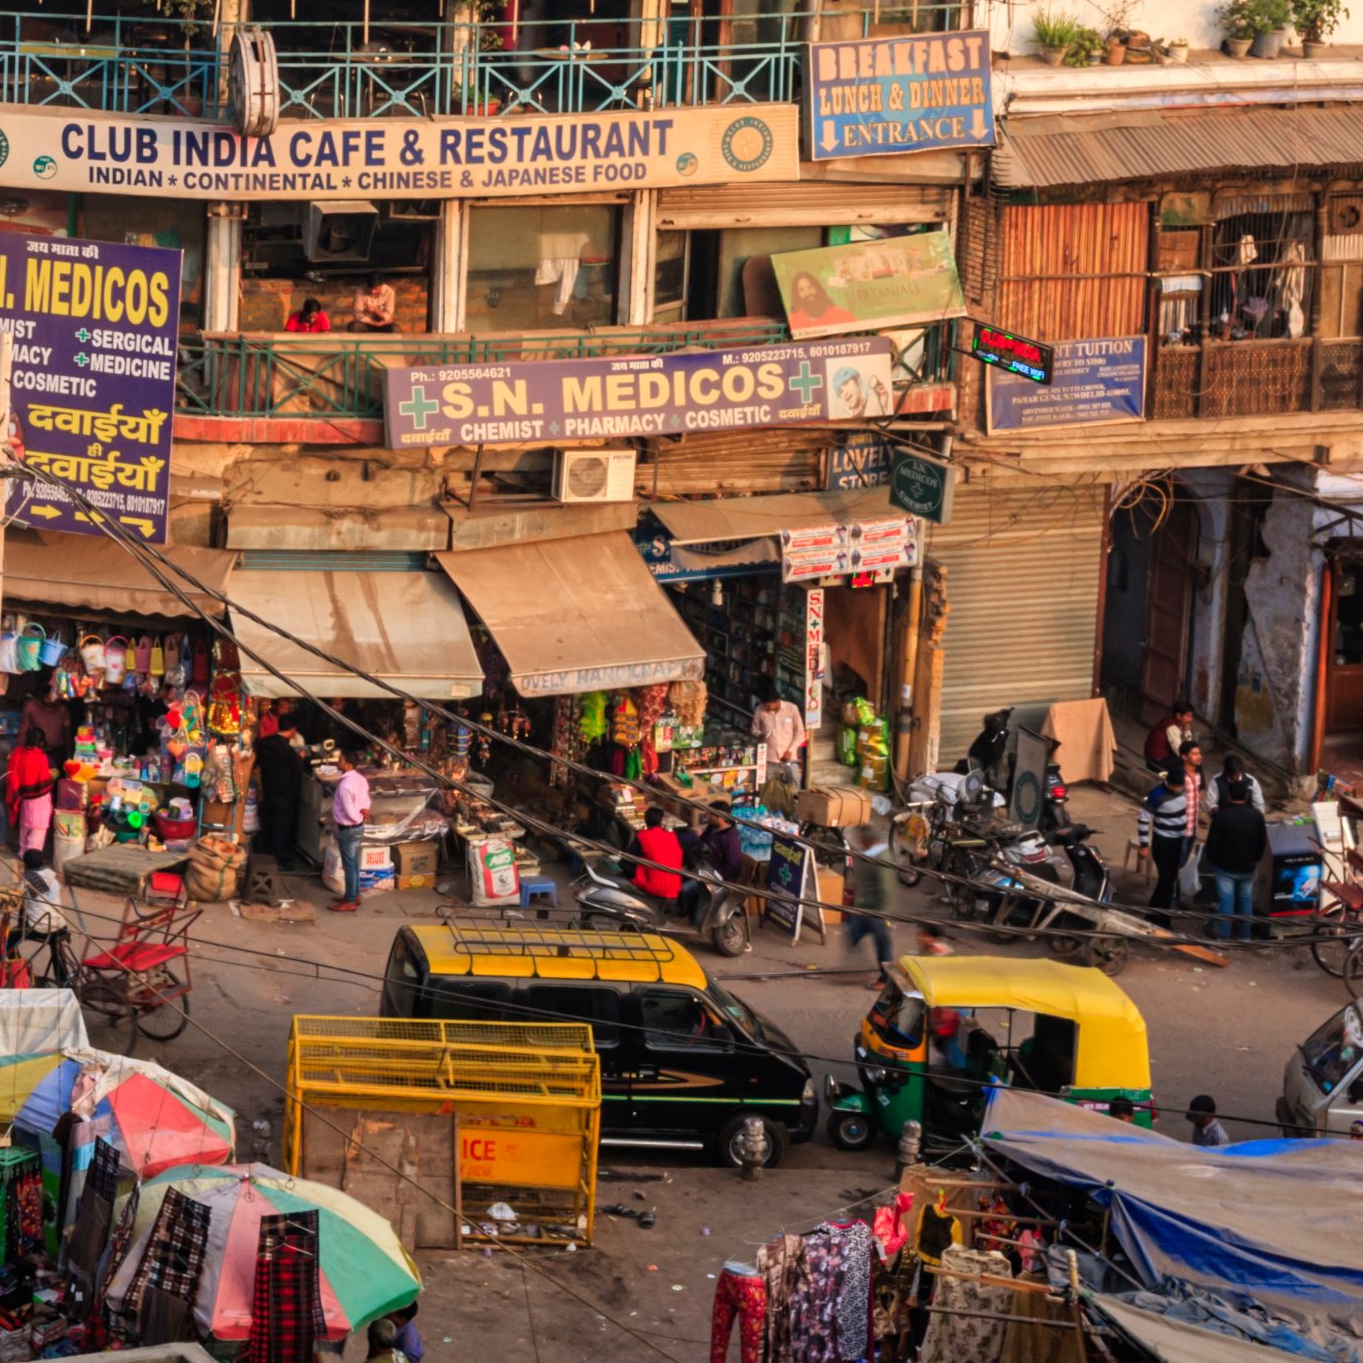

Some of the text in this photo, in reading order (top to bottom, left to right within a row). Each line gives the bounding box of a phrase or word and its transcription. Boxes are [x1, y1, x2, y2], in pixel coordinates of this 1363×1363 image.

[818, 38, 983, 82] BREAKFAST
[819, 76, 987, 117] LUNCH & DINNER
[61, 119, 674, 168] CLUB INDIA CAFE RESTAURANT
[842, 116, 966, 148] ENTRANCE
[88, 162, 648, 192] INDIAN CONTINENTAL CHINESE JAPANESE FOOD
[27, 241, 99, 259] जय माता की
[25, 257, 170, 328] MEDICOS
[91, 328, 175, 357] SERGICAL
[741, 341, 872, 365] 9205223715, 8010187917
[1076, 340, 1133, 356] TUITION
[89, 353, 171, 381] MEDICINE
[438, 366, 512, 382] 9205564621
[13, 369, 98, 398] COSMETIC
[441, 362, 785, 420] S.N. MEDICOS
[460, 404, 772, 443] CHEMIST PHARMACY COSMETIC
